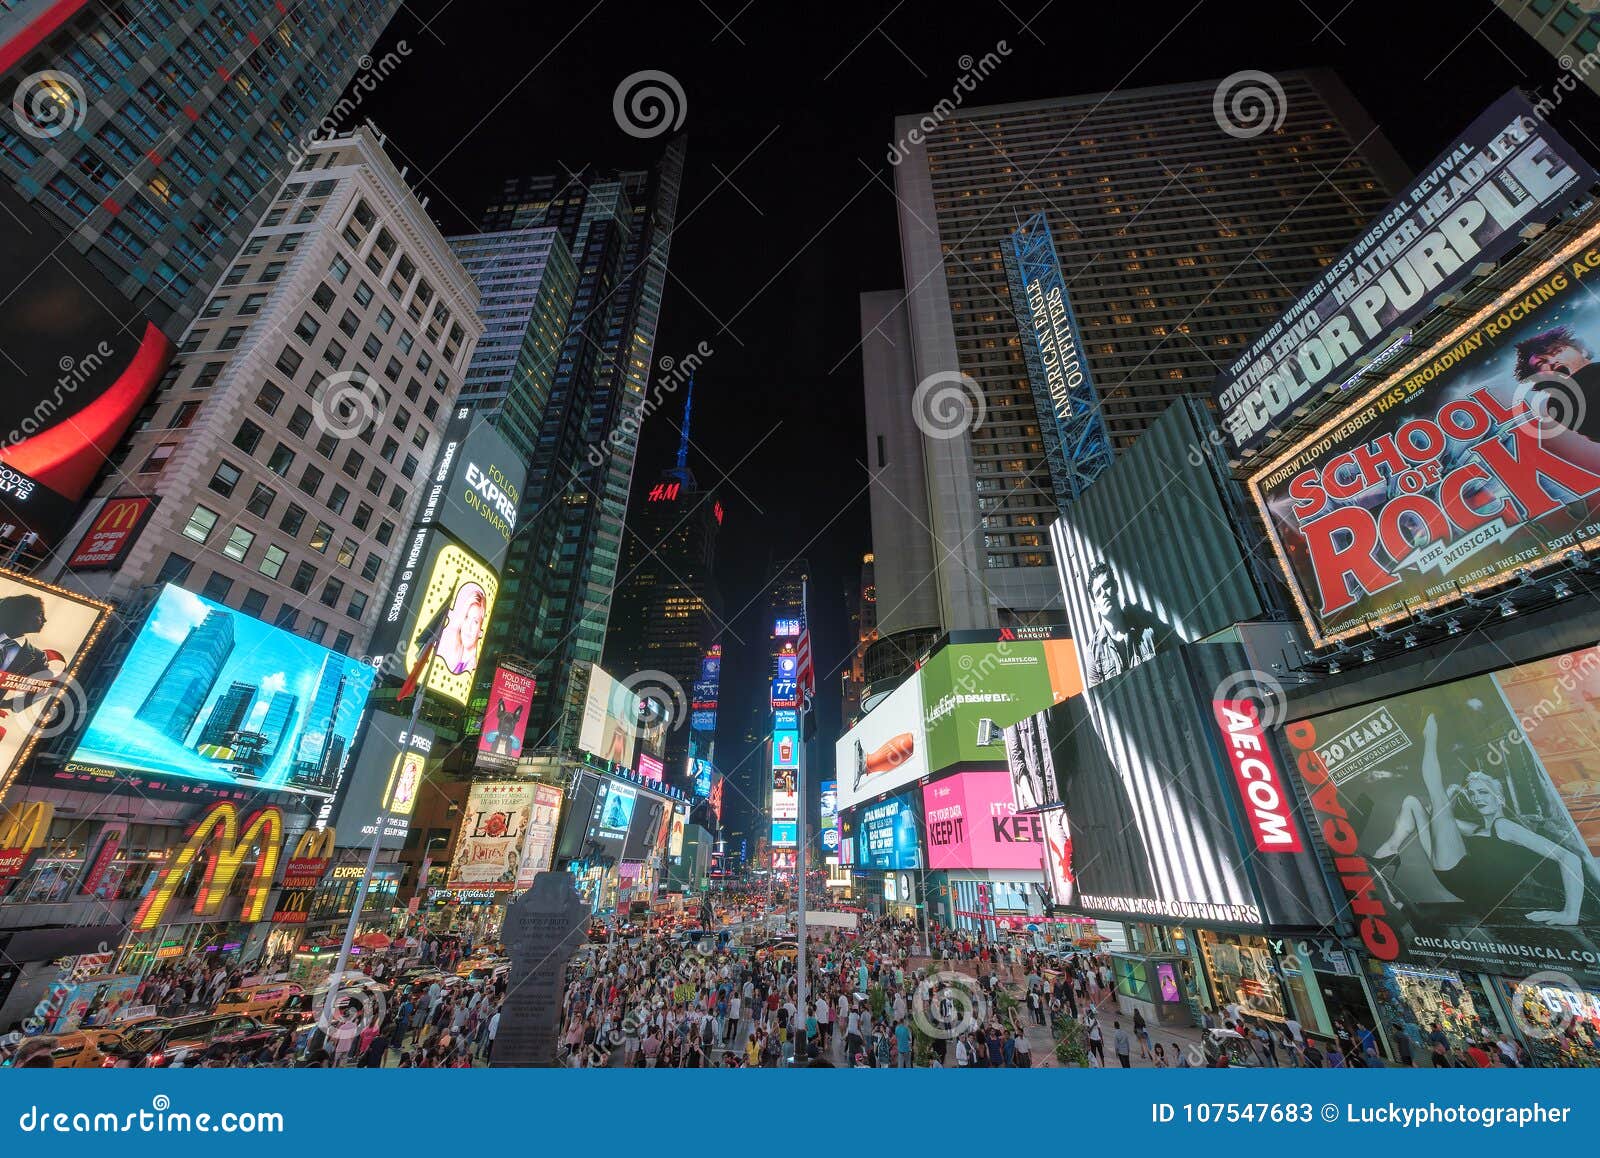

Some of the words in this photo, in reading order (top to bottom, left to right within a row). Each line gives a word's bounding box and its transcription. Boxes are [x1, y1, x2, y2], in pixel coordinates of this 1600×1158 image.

[1218, 355, 1274, 411] CYNTHIA
[1271, 310, 1321, 363] ERIVO
[1332, 218, 1419, 306] HEATHER
[1420, 114, 1531, 222] HEADLEY
[1230, 355, 1252, 376] TONY
[1251, 322, 1282, 356] AWARD
[1283, 280, 1326, 326] WINNER!
[1325, 253, 1355, 283] BEST
[1353, 201, 1413, 257] MUSICAL
[1413, 142, 1476, 204] REVIVAL
[1026, 278, 1048, 328] EAGLE
[1226, 405, 1253, 448] THE
[1242, 314, 1364, 433] COLOR
[1350, 136, 1577, 340] PURPLE
[1047, 287, 1083, 388] OUTFITTERS
[1038, 329, 1073, 419] AMERICAN
[1264, 458, 1302, 491] ANDREW
[1301, 436, 1332, 466] LLOYD
[1331, 408, 1377, 450] WEBBER
[1377, 390, 1406, 413] HAS
[1404, 335, 1484, 396] BROADWAY
[1484, 275, 1568, 338] ROCKING
[437, 442, 457, 482] EXPRESS
[1288, 386, 1533, 521] SCHOOL
[488, 463, 520, 506] FOLLOW
[1397, 459, 1442, 495] OF
[15, 487, 30, 500] 15
[428, 484, 443, 507] FOLLOW
[464, 489, 480, 512] ON
[465, 461, 518, 531] EXPRES
[648, 483, 680, 502] H&M
[1300, 414, 1600, 618] ROCK
[88, 540, 117, 552] 24
[93, 531, 126, 540] OPEN
[1443, 524, 1503, 565] MUSICAL
[75, 553, 116, 562] HOURS
[1420, 545, 1443, 566] THE
[1325, 594, 1422, 636] SchoolOfRocTheMusicalcom
[1458, 564, 1497, 585] GARDEN
[1496, 547, 1541, 571] THEATRE
[1547, 533, 1576, 552] 50TH
[776, 620, 800, 629] 11:53
[1000, 656, 1038, 664] HARRYS.COM
[6, 674, 20, 682] SEE
[19, 675, 28, 683] IT
[502, 671, 520, 683] HOLD
[520, 677, 532, 688] THE
[504, 680, 527, 694] PHONE
[399, 731, 432, 753] EPRESS
[1320, 744, 1345, 767] 20
[1340, 713, 1393, 753] YEARS
[1364, 737, 1402, 764] WORLDWIDE
[1222, 708, 1293, 844] AE.COM
[990, 802, 1017, 816] IT'S
[929, 819, 953, 847] KEEP
[954, 818, 964, 844] IT
[992, 816, 1044, 843] KEE
[1285, 719, 1400, 961] CHICAGO
[333, 867, 367, 878] EXPRES
[458, 889, 495, 899] LUGGAGE
[1081, 894, 1132, 913] AMERICAN
[1132, 897, 1168, 916] EAGLE
[1169, 900, 1262, 924] OUTFITTERS
